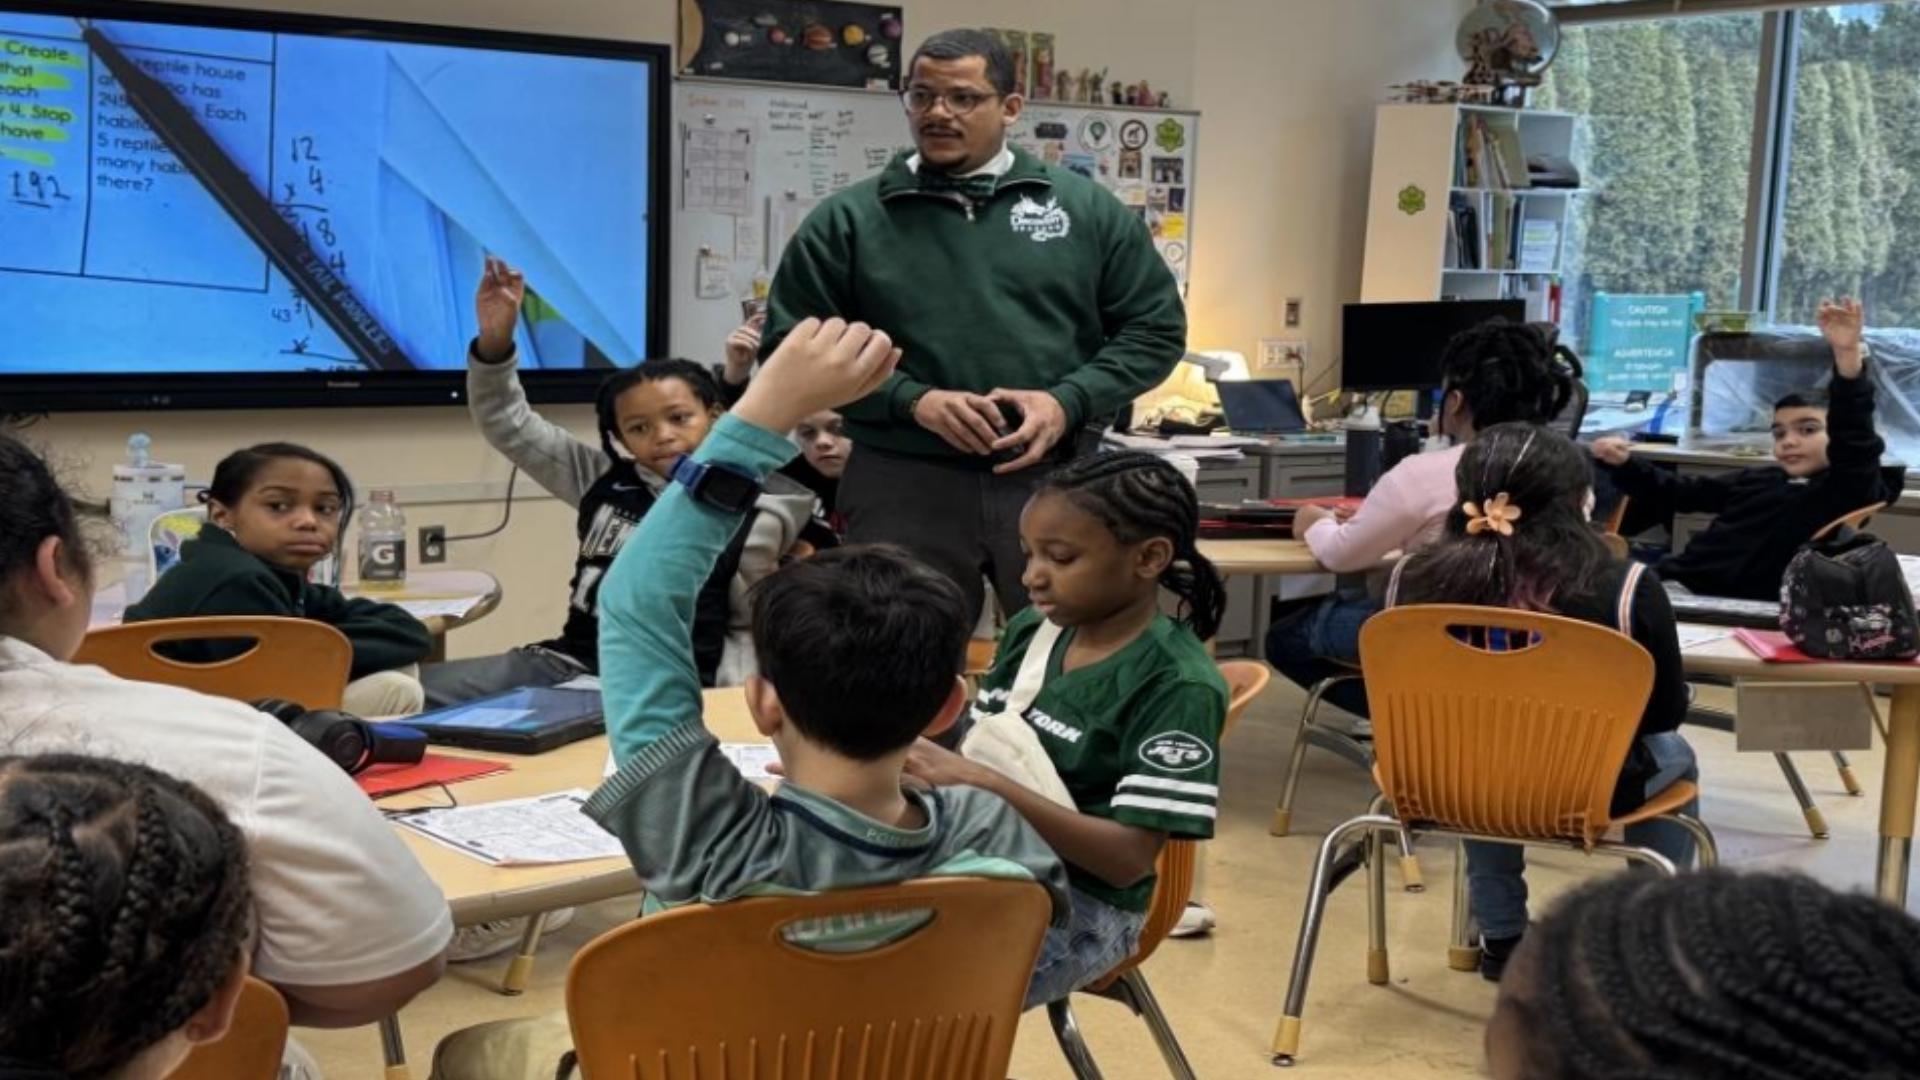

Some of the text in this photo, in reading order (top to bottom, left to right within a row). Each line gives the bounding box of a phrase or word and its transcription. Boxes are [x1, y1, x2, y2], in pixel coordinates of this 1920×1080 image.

[6, 40, 70, 61] Create
[195, 61, 247, 81] house
[192, 82, 222, 99] has
[31, 105, 72, 125] Stop
[205, 104, 247, 121] Each
[1, 125, 44, 141] have
[97, 132, 108, 147] 5
[291, 136, 321, 162] 12
[97, 157, 144, 174] many
[97, 174, 155, 191] there?
[316, 217, 337, 247] 8
[1627, 304, 1669, 315] CAUTION
[372, 544, 396, 565] G
[1026, 707, 1083, 743] YORK
[1147, 745, 1203, 764] JETS
